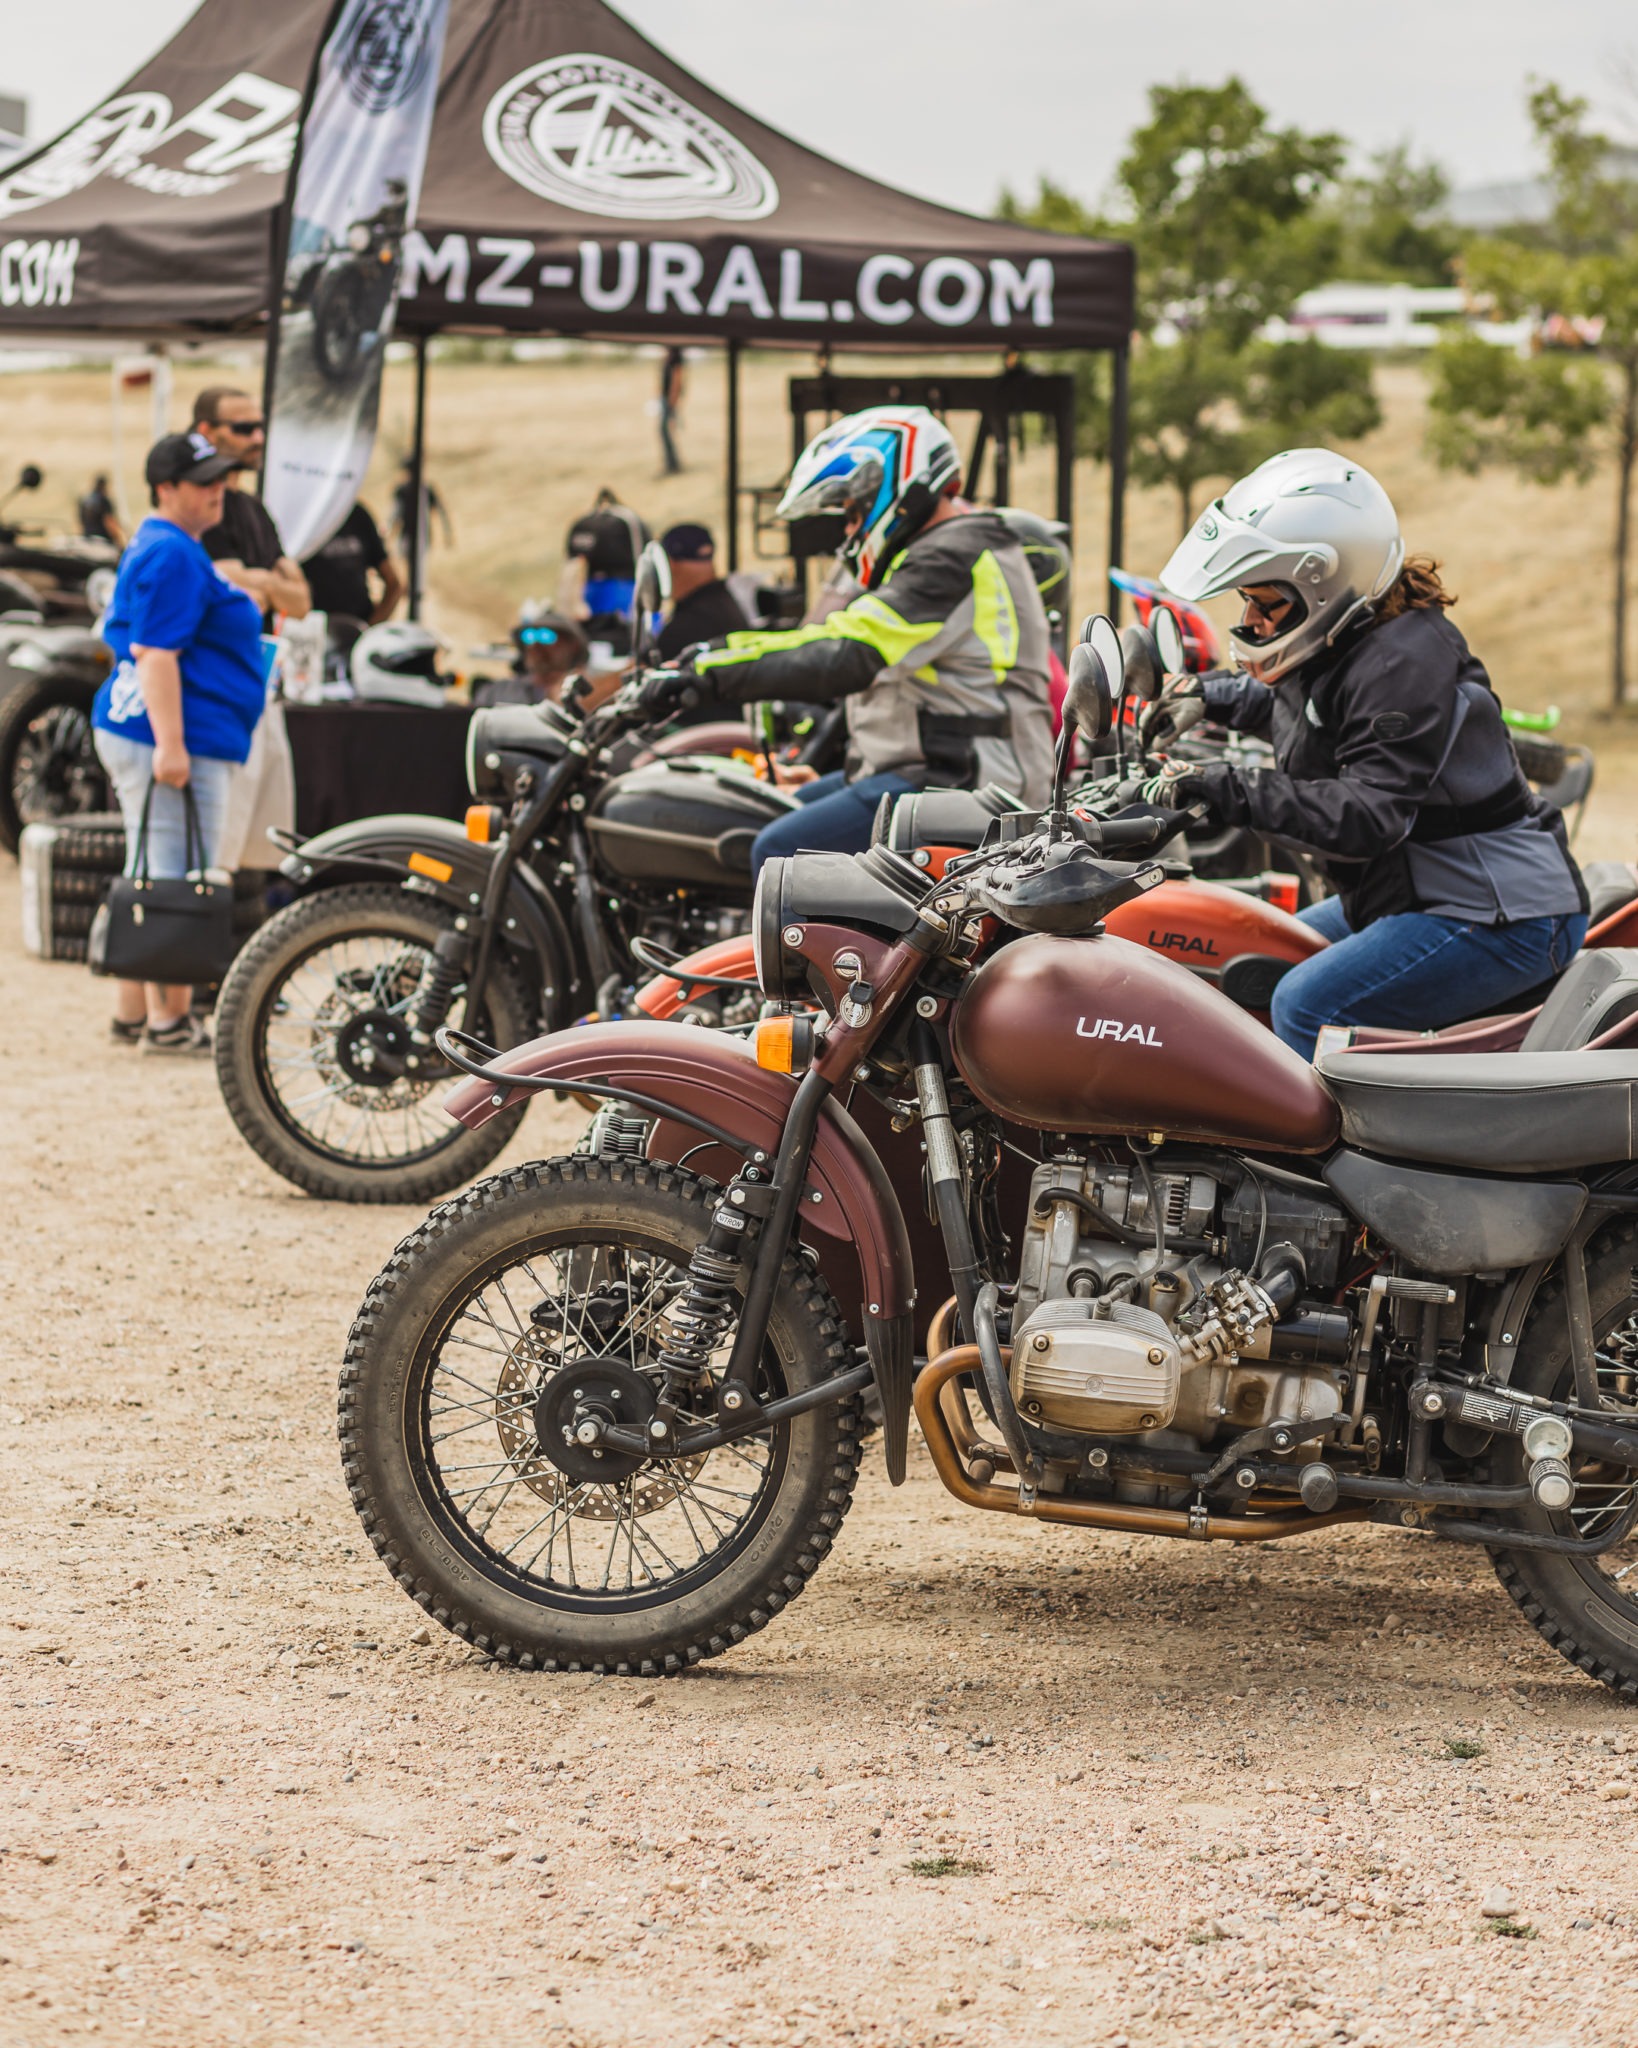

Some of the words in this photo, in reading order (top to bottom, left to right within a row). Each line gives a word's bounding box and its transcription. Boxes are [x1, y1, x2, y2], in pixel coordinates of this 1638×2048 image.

[1149, 931, 1219, 956] URAL
[1076, 1017, 1163, 1047] URAL
[718, 1214, 742, 1228] NITRON
